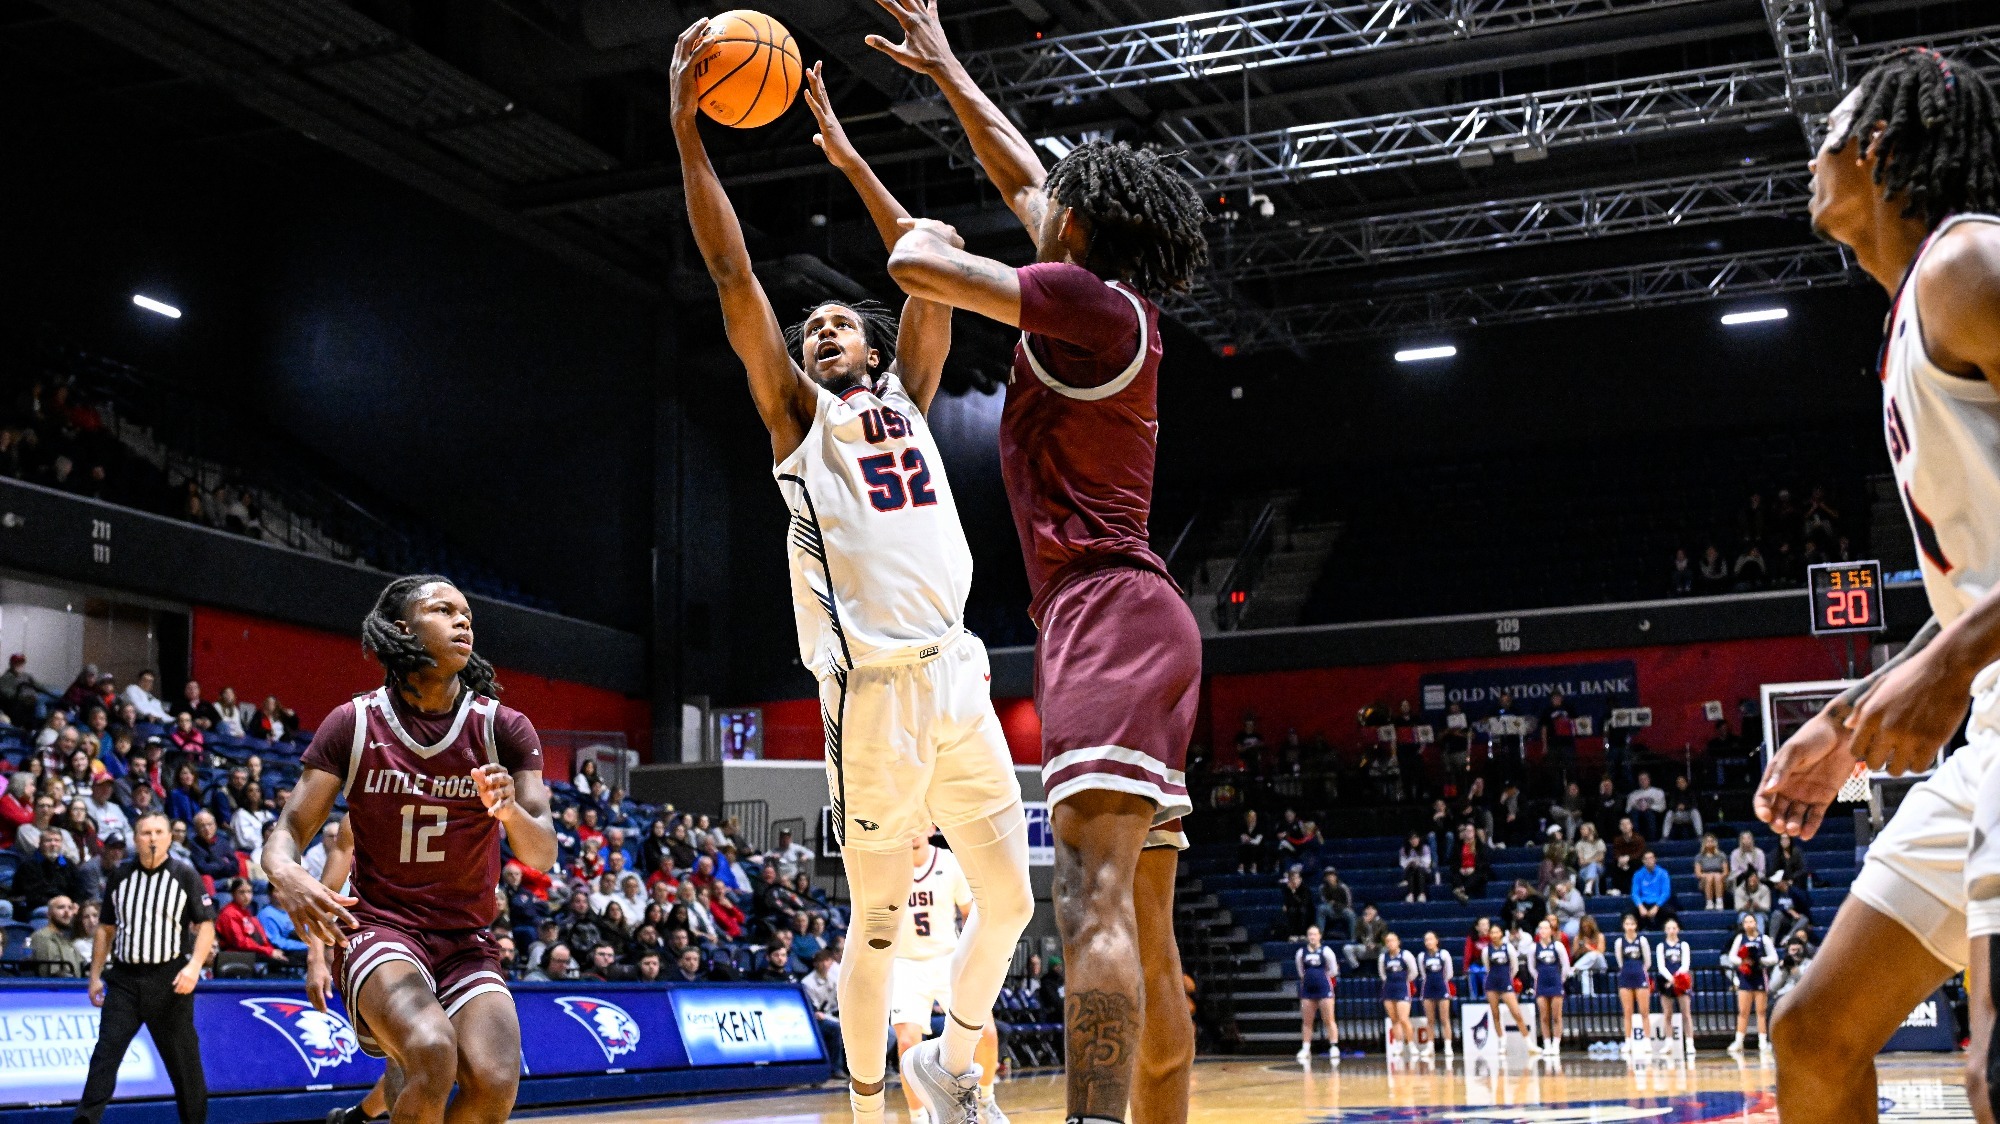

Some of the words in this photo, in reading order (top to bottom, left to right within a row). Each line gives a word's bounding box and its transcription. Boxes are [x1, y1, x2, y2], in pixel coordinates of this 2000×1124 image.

[858, 405, 915, 444] USI
[857, 447, 938, 512] 52
[1826, 589, 1870, 627] 20
[1499, 636, 1521, 652] 109
[1450, 687, 1486, 703] OLD
[1488, 682, 1579, 700] NTIONAL
[1580, 678, 1631, 695] BANK
[364, 768, 427, 796] LITTLE
[399, 804, 449, 863] 12
[908, 890, 934, 908] USI
[913, 911, 931, 937] 5
[0, 1014, 100, 1042] I-STATE
[715, 1010, 767, 1043] KENT
[1633, 1026, 1680, 1041] BUE
